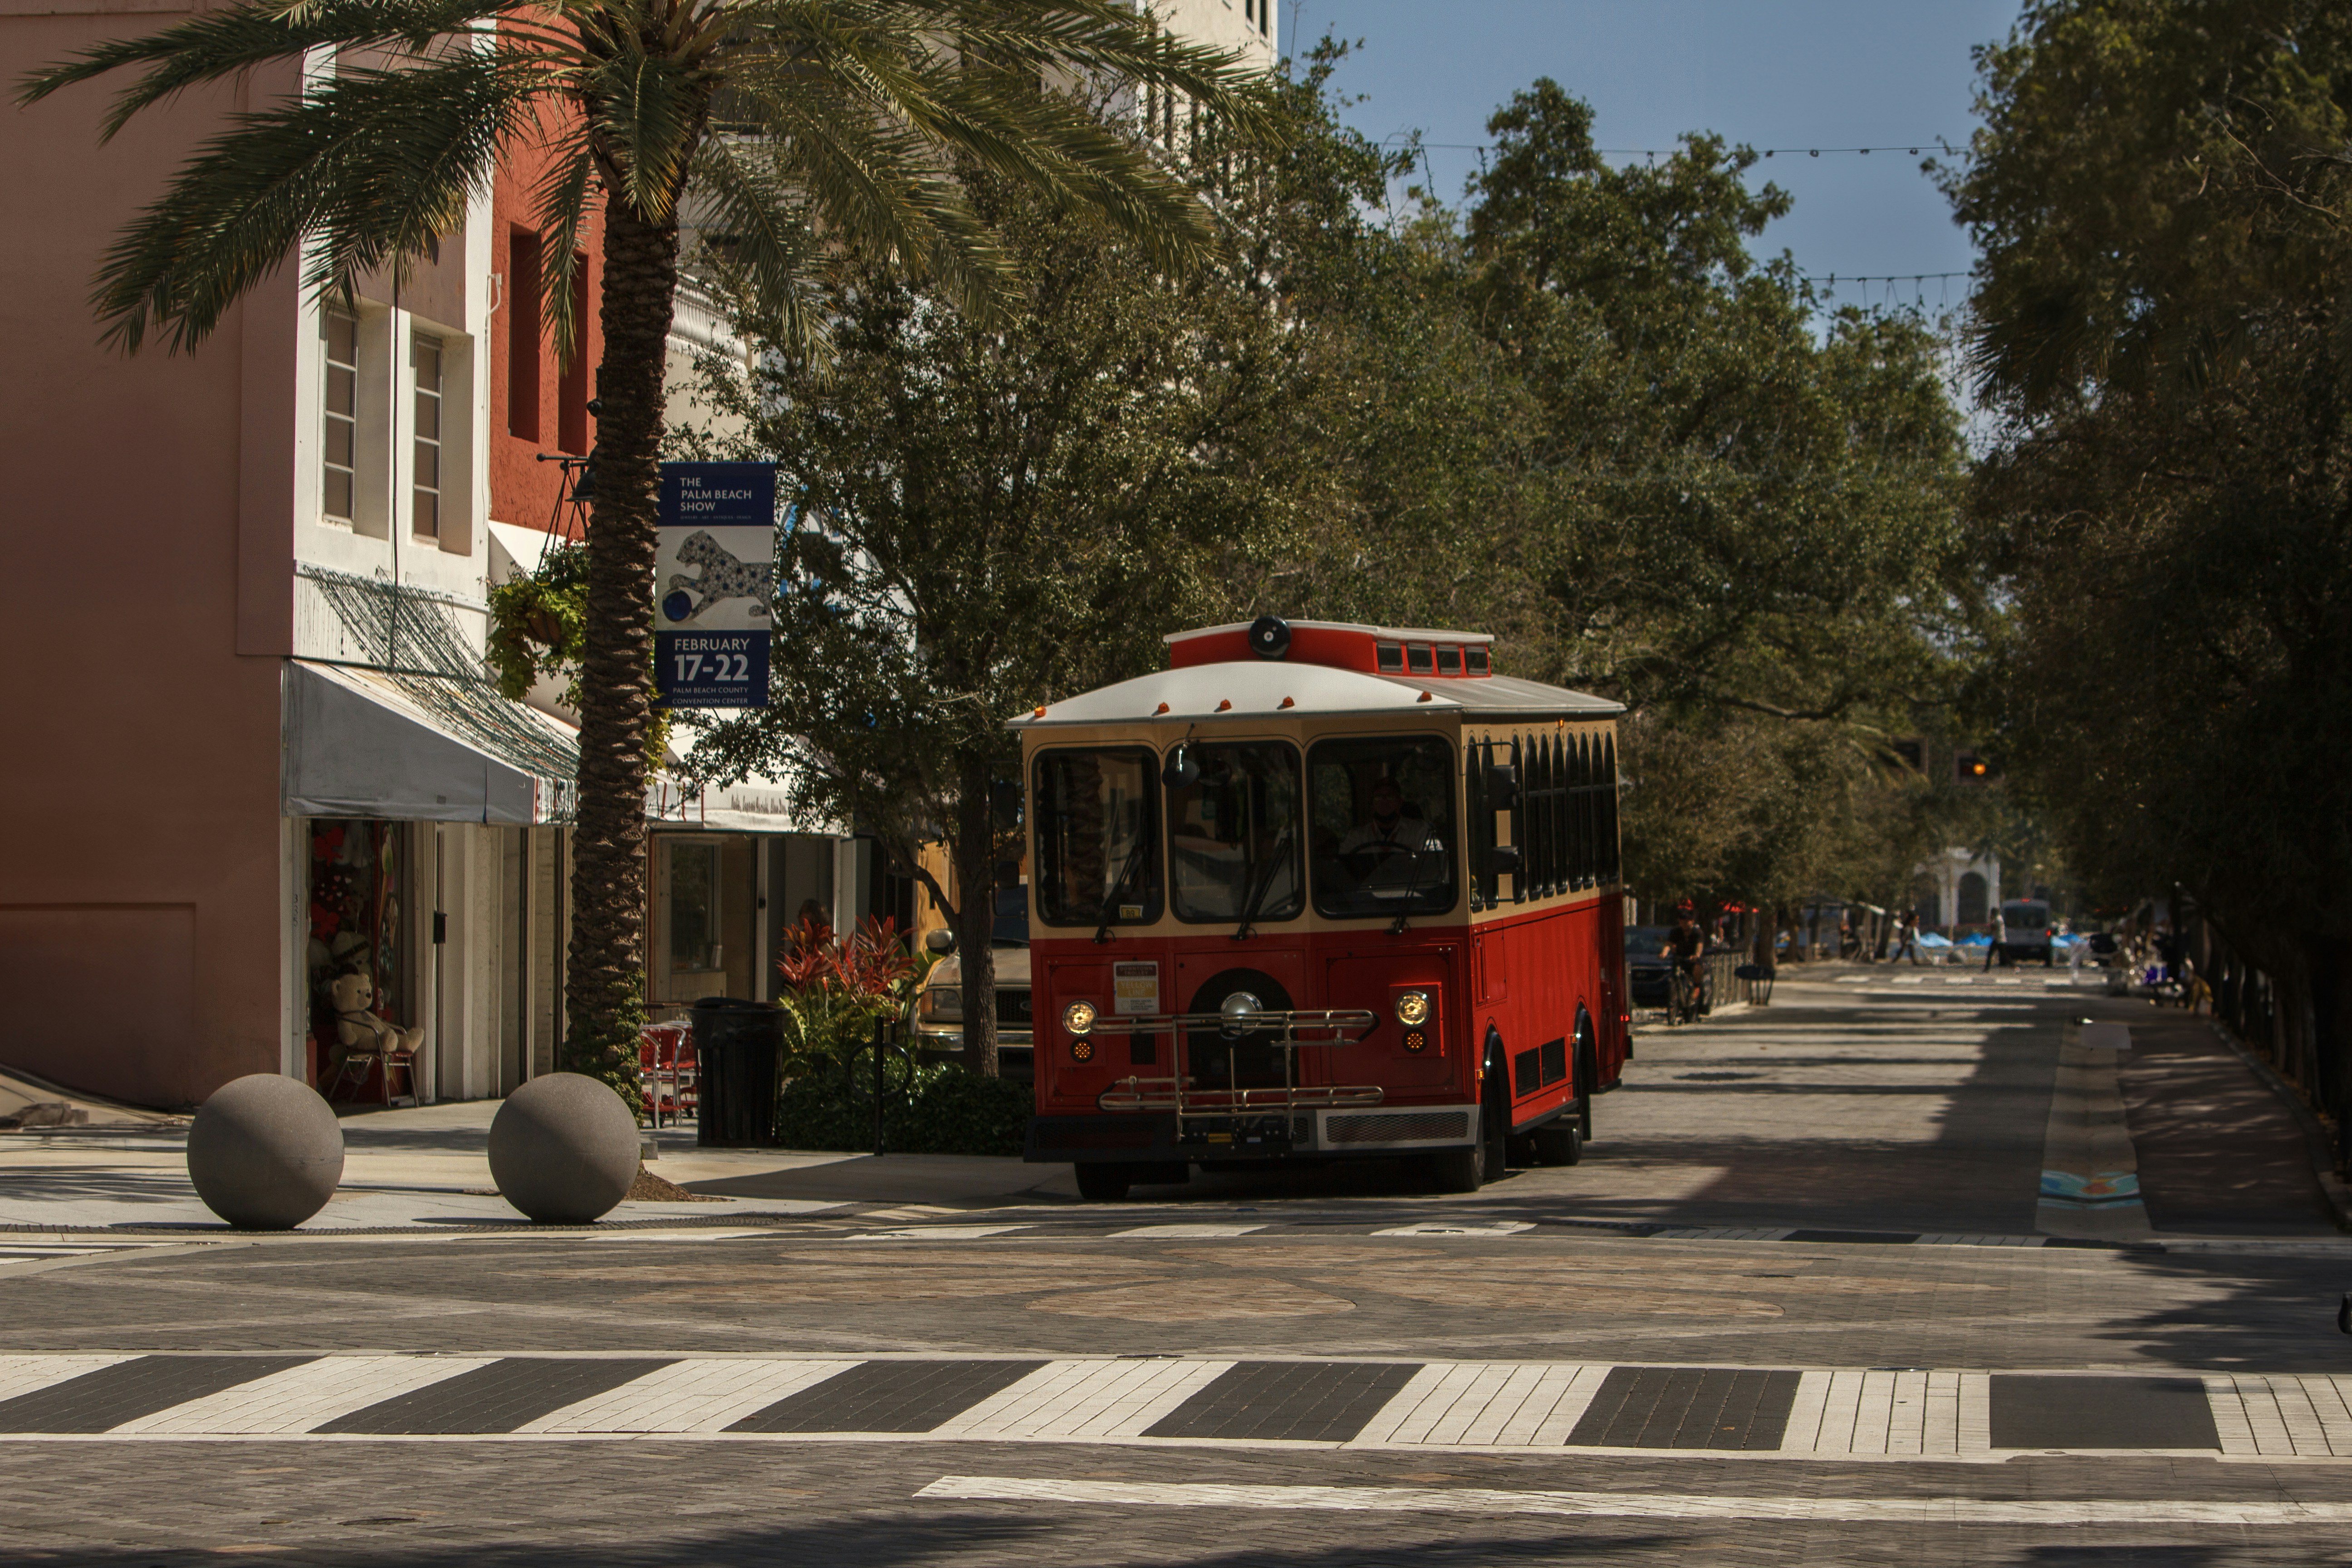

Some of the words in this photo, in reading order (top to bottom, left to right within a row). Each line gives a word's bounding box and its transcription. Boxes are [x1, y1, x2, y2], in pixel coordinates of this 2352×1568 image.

[680, 477, 701, 487] THE
[682, 490, 711, 500] PALM
[715, 490, 752, 500] BEACH
[680, 502, 715, 511] SHOW
[675, 638, 750, 651] FEBRUARY
[674, 654, 749, 681] 17-22
